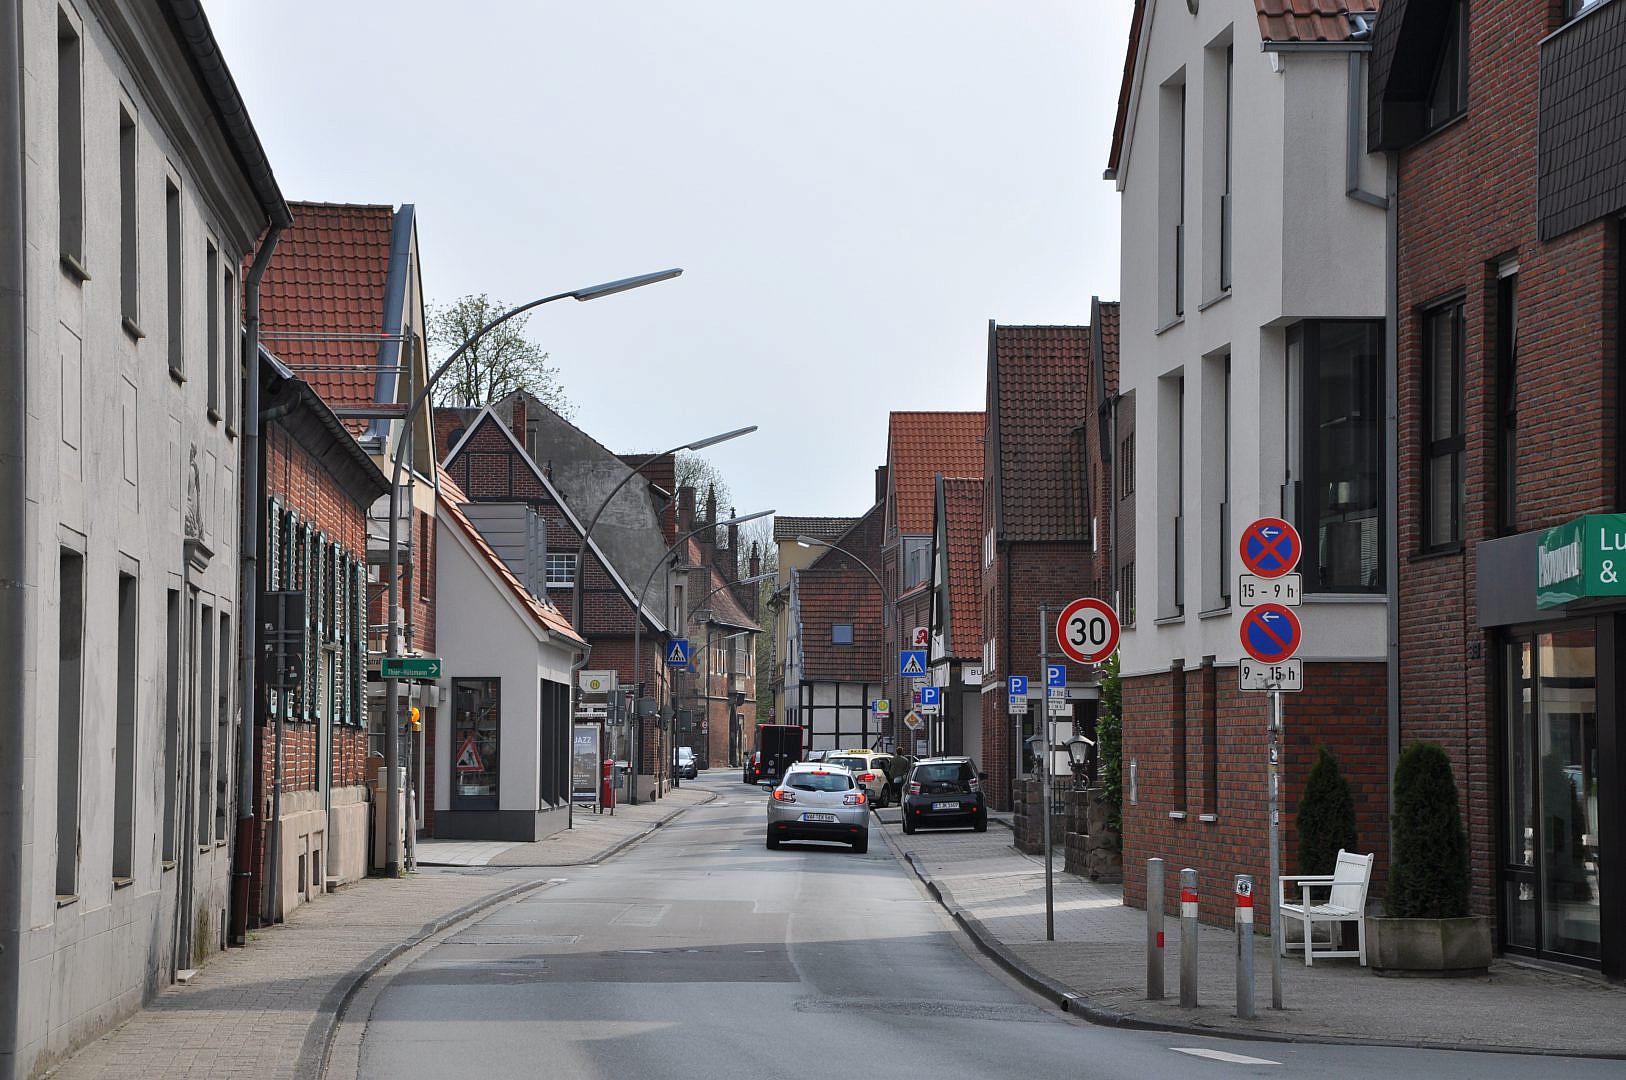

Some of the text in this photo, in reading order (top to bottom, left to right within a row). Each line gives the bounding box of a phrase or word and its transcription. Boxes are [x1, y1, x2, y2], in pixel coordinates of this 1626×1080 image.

[1599, 559, 1619, 583] &
[1242, 584, 1255, 598] 15
[1274, 584, 1281, 598] 9
[1287, 584, 1294, 598] h
[1070, 617, 1106, 646] 30
[1047, 667, 1060, 685] P
[1243, 666, 1250, 680] 9
[1269, 666, 1282, 681] 15
[1288, 666, 1295, 681] h
[1011, 678, 1022, 693] P
[925, 689, 935, 703] P
[574, 736, 592, 744] JAZZ
